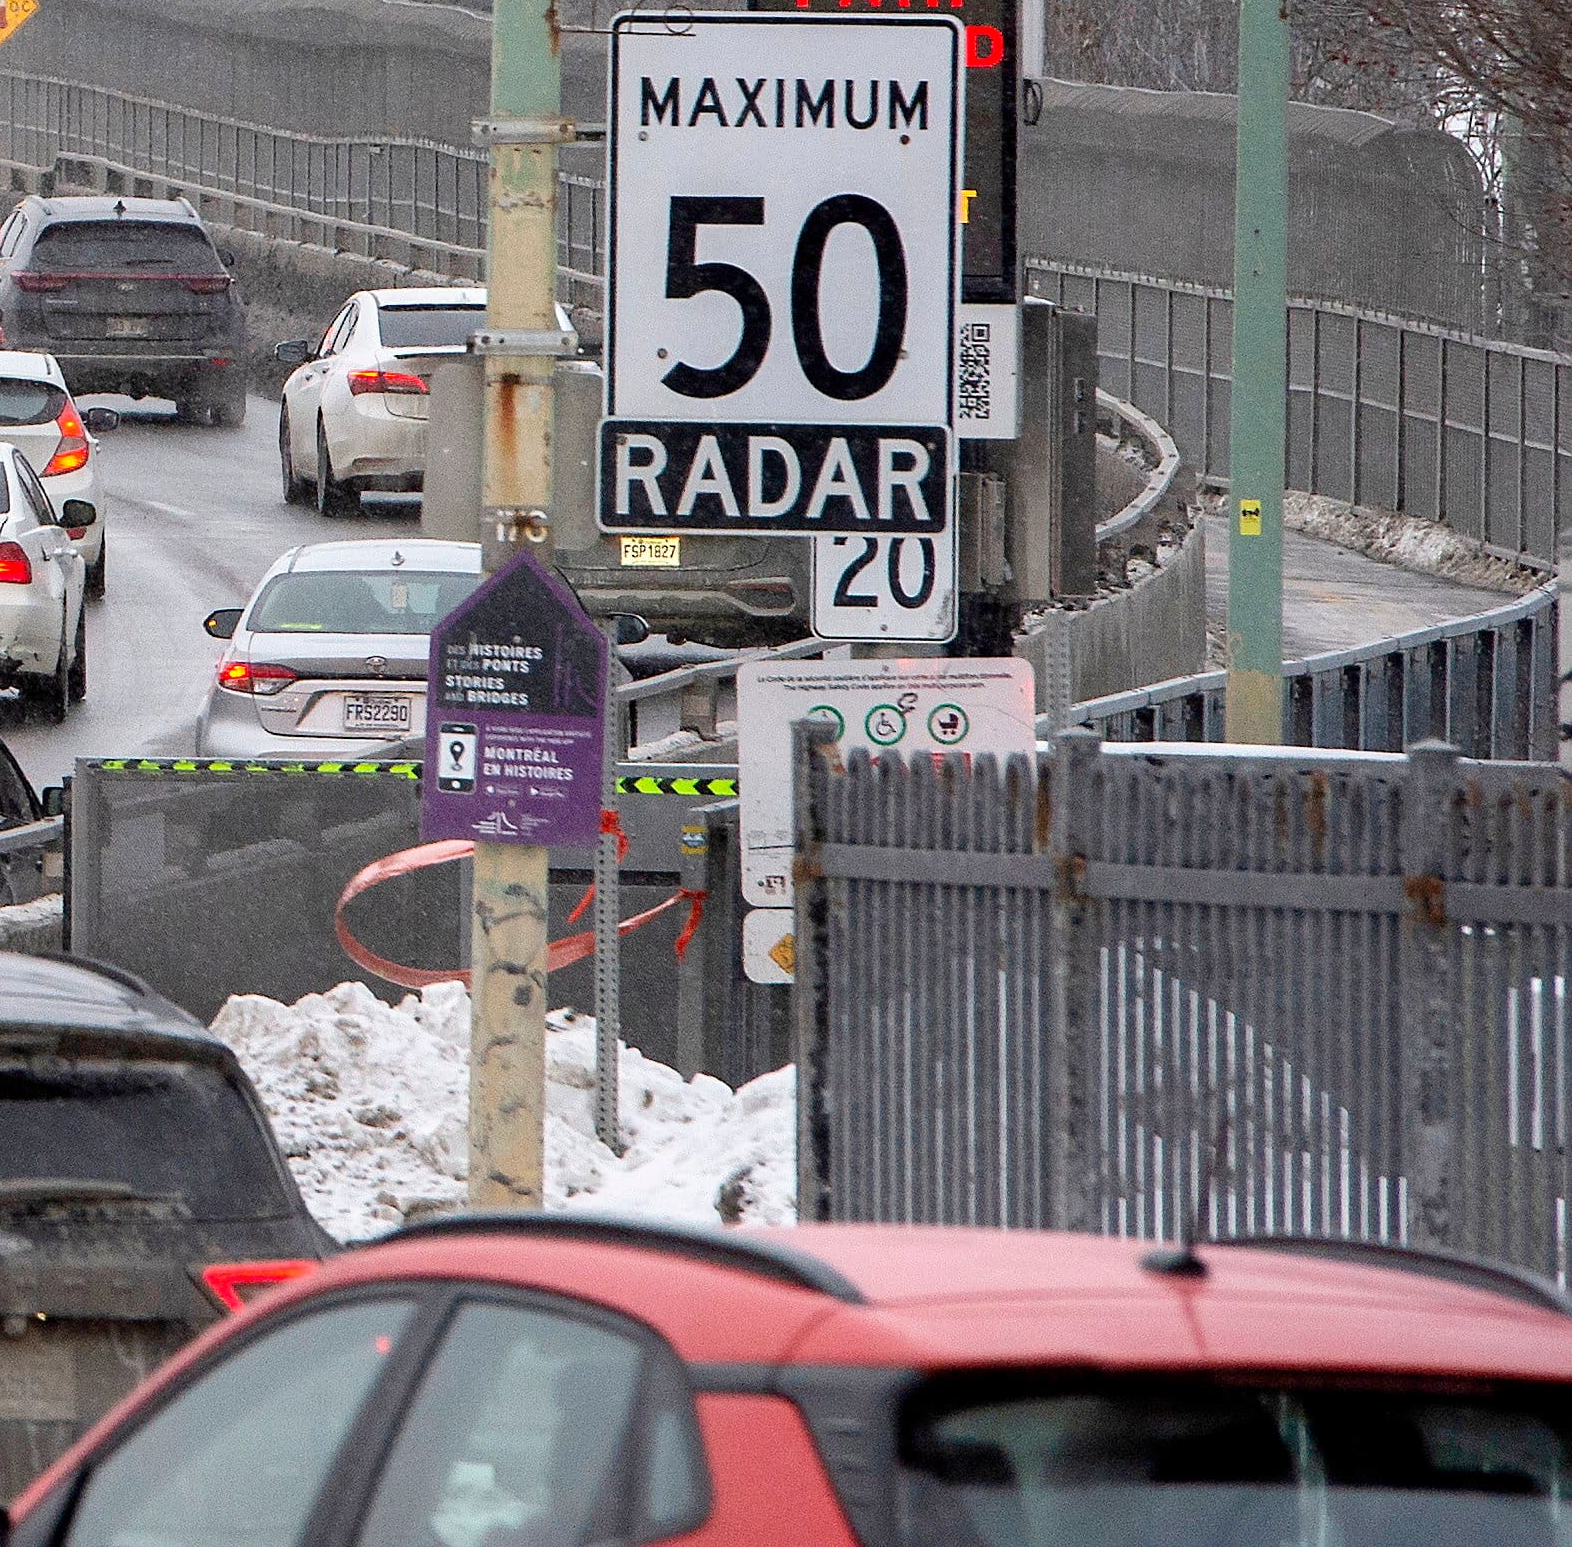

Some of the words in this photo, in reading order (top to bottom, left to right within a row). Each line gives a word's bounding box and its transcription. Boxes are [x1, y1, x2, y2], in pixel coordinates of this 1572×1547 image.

[640, 76, 930, 132] MAXIMUM
[657, 193, 909, 401] 50
[615, 433, 932, 521] RADAR
[624, 544, 677, 559] FSP1827
[833, 536, 936, 610] 20
[468, 642, 543, 660] HISTOIRES
[482, 658, 530, 674] PONTS
[445, 674, 506, 691] STORIES
[466, 690, 530, 706] BRIDGES
[484, 745, 560, 764] MONTRÉAL
[483, 763, 501, 777] EN
[504, 764, 575, 782] HISTOIRES
